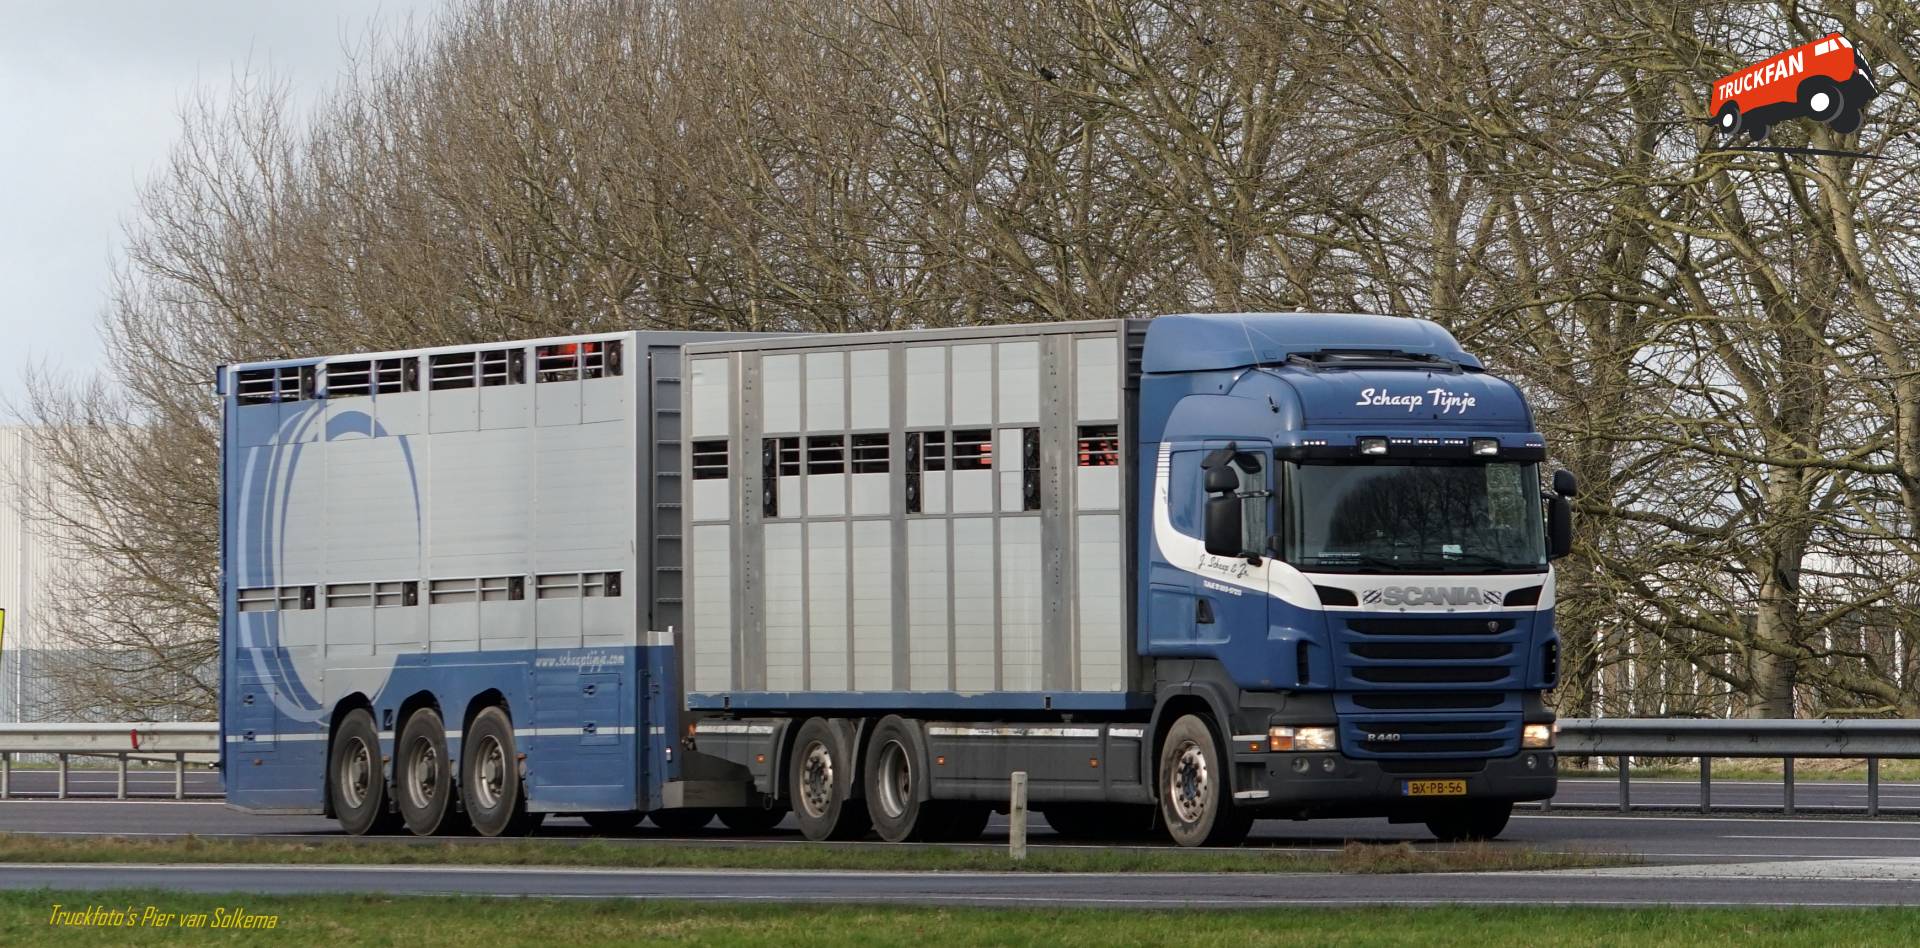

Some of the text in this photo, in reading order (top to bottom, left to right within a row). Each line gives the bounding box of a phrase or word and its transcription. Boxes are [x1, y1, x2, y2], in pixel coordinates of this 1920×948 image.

[1356, 388, 1476, 414] Schaap Tijnje
[1383, 586, 1483, 606] SCANIA
[1367, 733, 1400, 741] R 440
[1411, 782, 1463, 794] BX-PB-56
